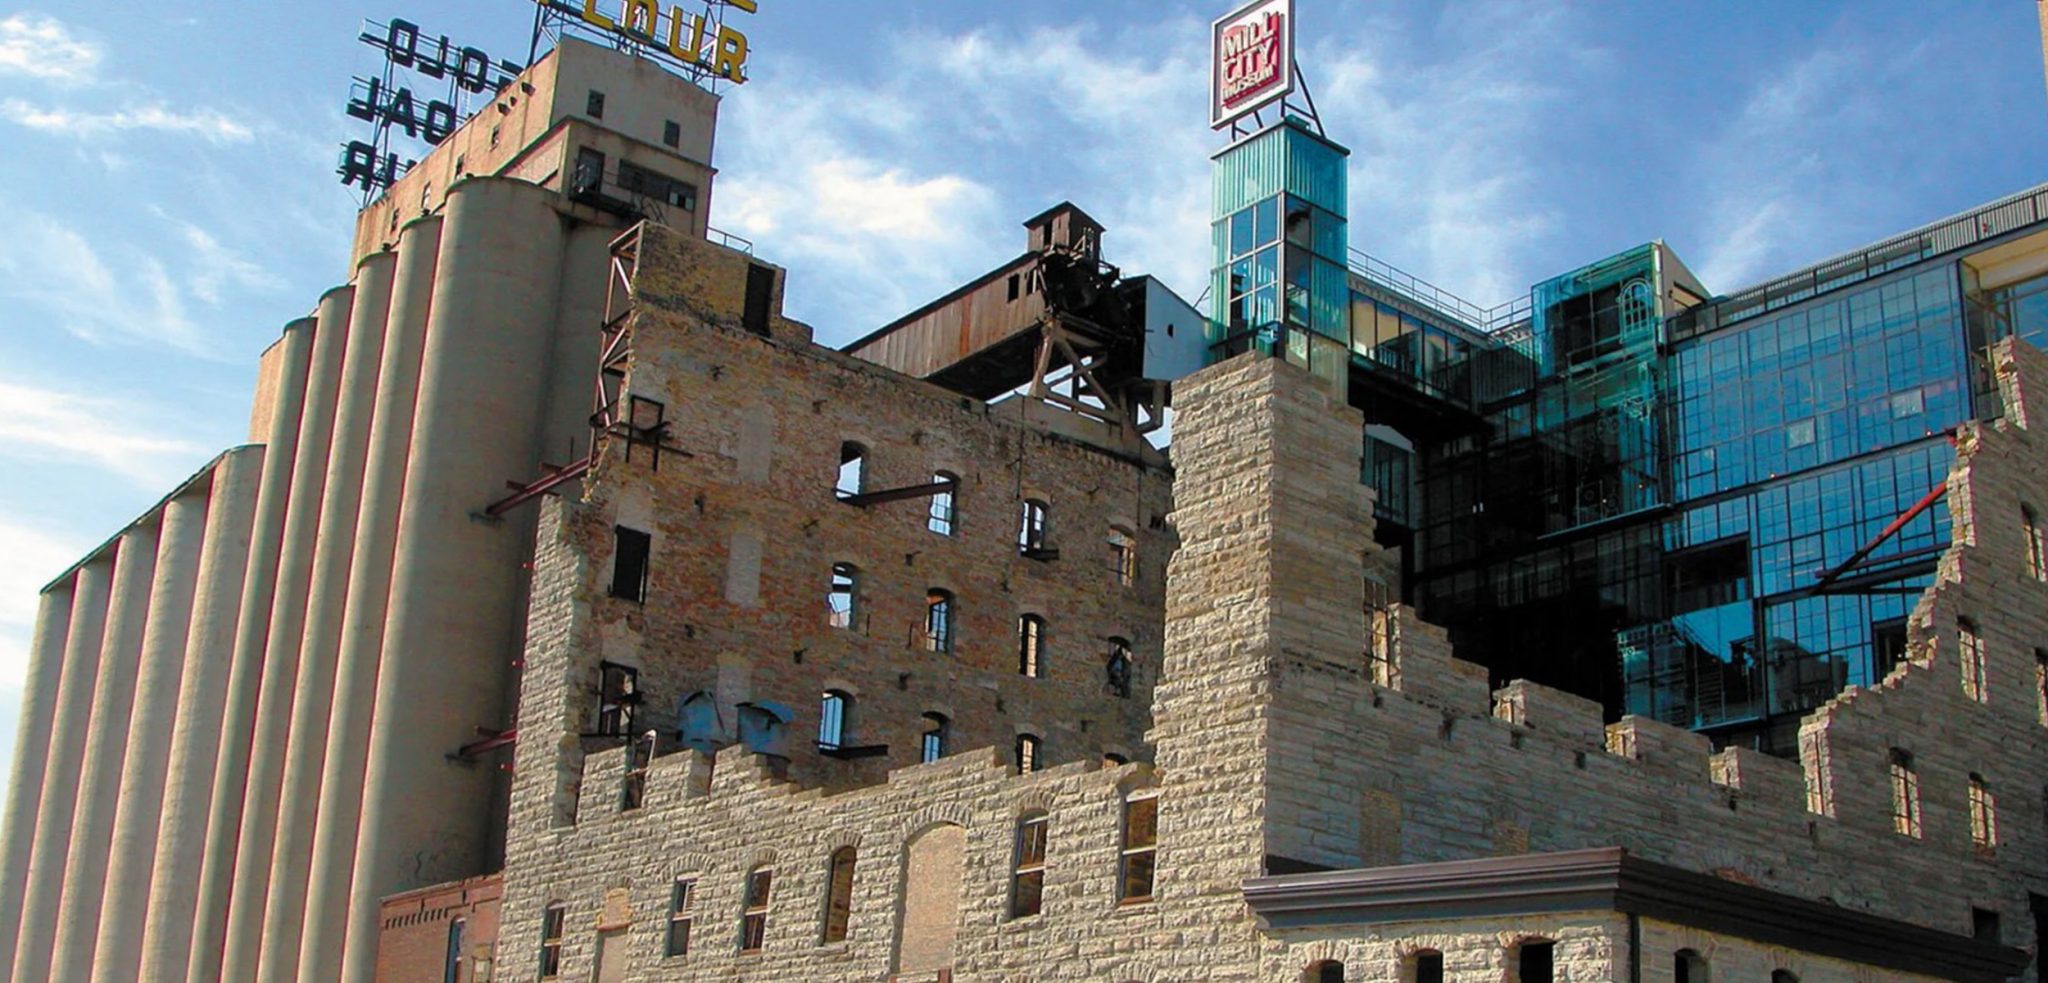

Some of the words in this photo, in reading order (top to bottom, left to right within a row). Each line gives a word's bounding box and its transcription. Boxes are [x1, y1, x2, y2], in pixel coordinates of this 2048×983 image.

[534, 0, 746, 84] LOUR
[1222, 11, 1276, 60] MILL
[1223, 37, 1276, 85] CITY
[1223, 64, 1275, 99] MUSEUM
